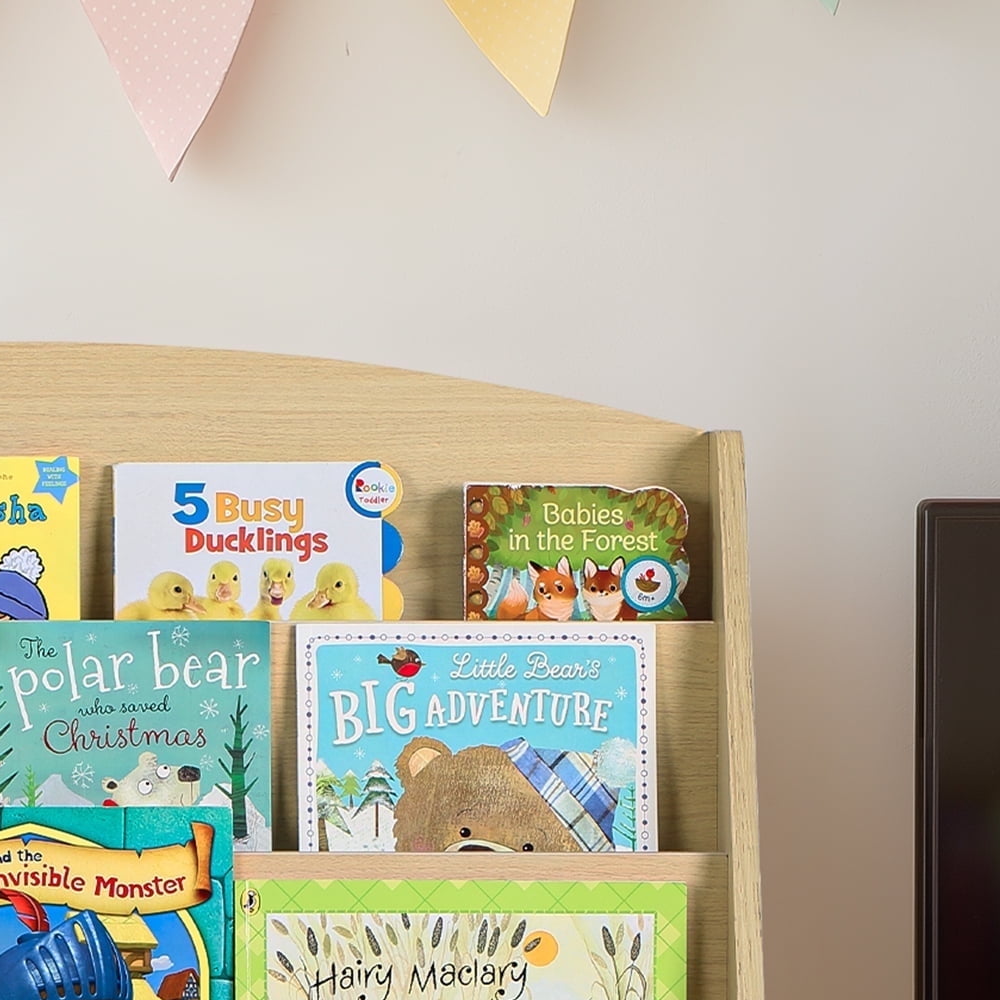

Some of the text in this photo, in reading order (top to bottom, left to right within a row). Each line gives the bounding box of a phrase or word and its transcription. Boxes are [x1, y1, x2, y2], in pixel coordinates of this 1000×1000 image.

[355, 479, 395, 493] Rookie
[172, 482, 304, 533] 5 Busy
[359, 496, 389, 504] Toddler
[543, 502, 624, 526] Babies
[185, 527, 329, 562] Ducklings
[509, 529, 659, 551] in the Forest
[19, 636, 58, 660] The
[449, 651, 601, 680] Little Bear's
[7, 640, 134, 732] polar
[147, 631, 260, 692] bear
[78, 695, 171, 718] who saved
[329, 680, 613, 746] BIG ADVENTURE
[42, 718, 207, 755] Christmas
[17, 849, 43, 863] the
[94, 873, 186, 899] Monster
